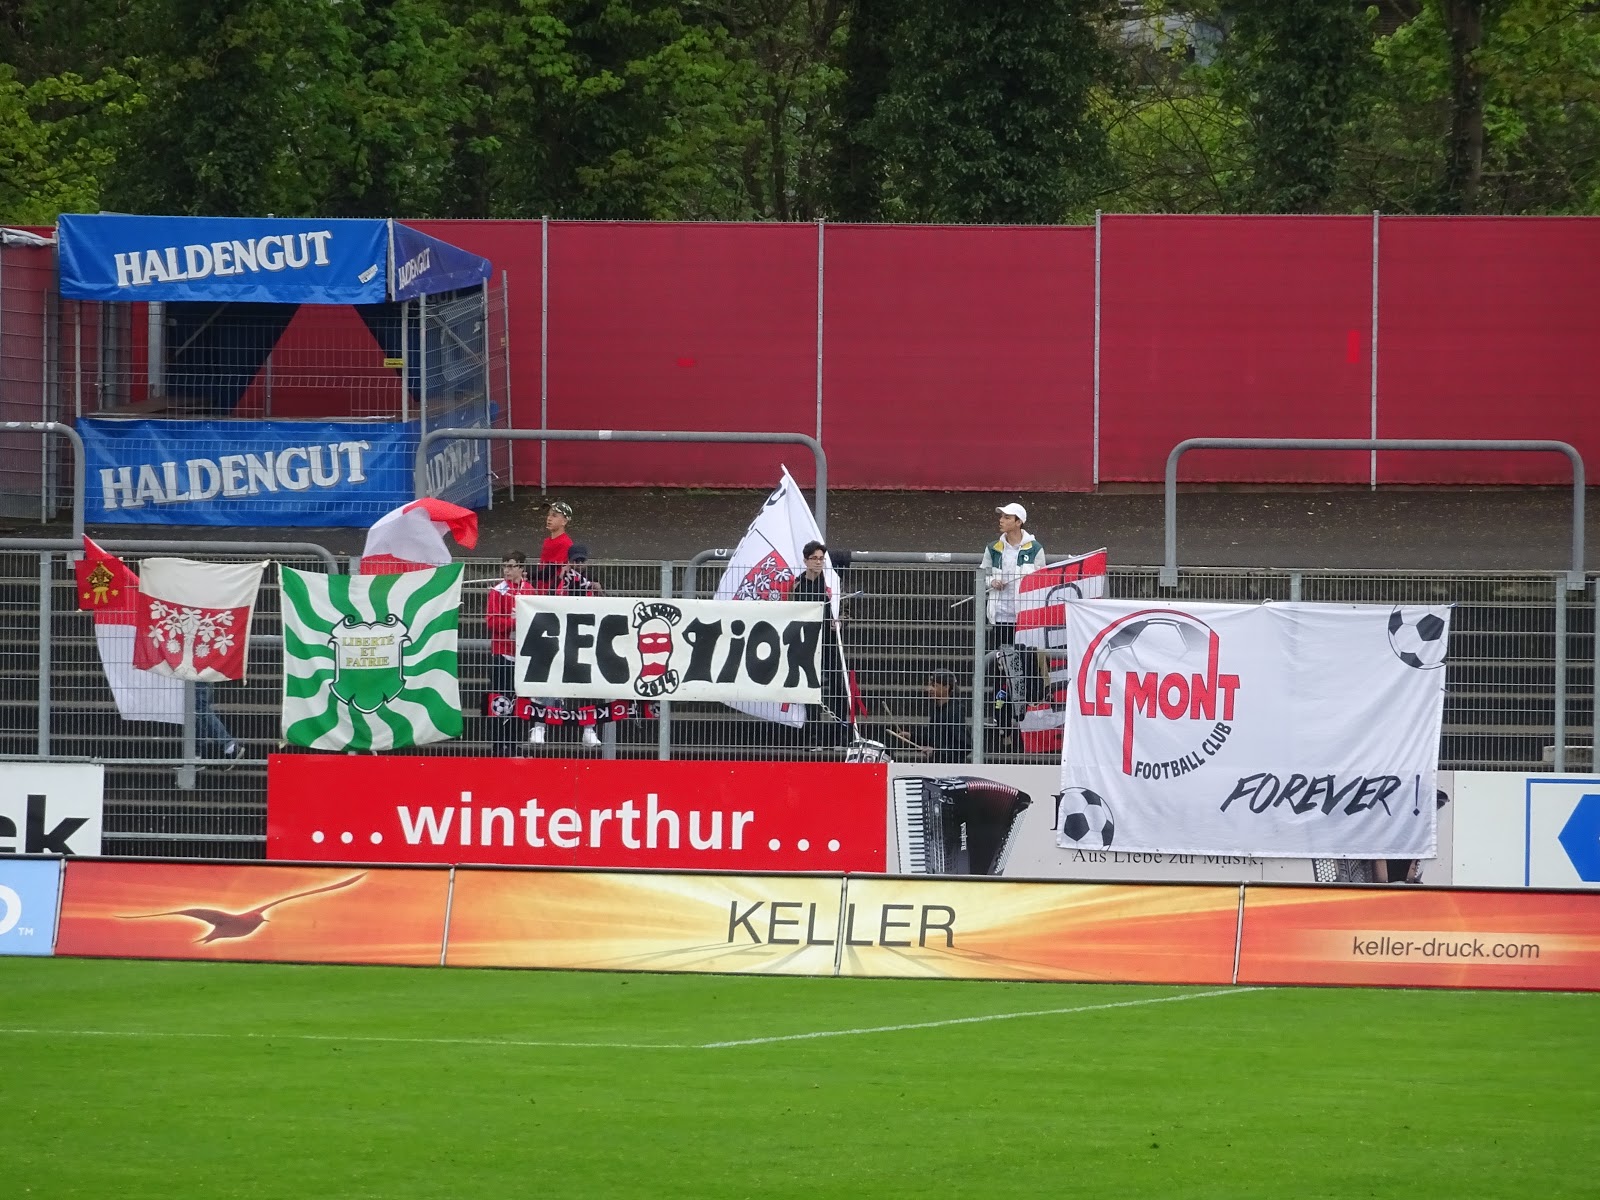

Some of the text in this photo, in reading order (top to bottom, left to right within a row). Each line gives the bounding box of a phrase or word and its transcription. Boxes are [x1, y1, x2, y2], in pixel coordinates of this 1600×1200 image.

[114, 230, 333, 288] HALDENGUT
[425, 423, 481, 498] ALDENGUT
[100, 440, 371, 511] HALDENGUT
[342, 634, 395, 647] LIBERTÉ
[360, 647, 377, 657] ET
[345, 656, 390, 667] PATRIE
[523, 703, 636, 720] FC KLINGNAU
[1134, 721, 1232, 780] FOOTBALL CLUB
[1219, 773, 1402, 816] FOREVER
[1072, 849, 1107, 863] Aus
[18, 927, 34, 937] TM
[727, 901, 957, 949] KELLER
[1352, 936, 1541, 959] keller-druck.com
